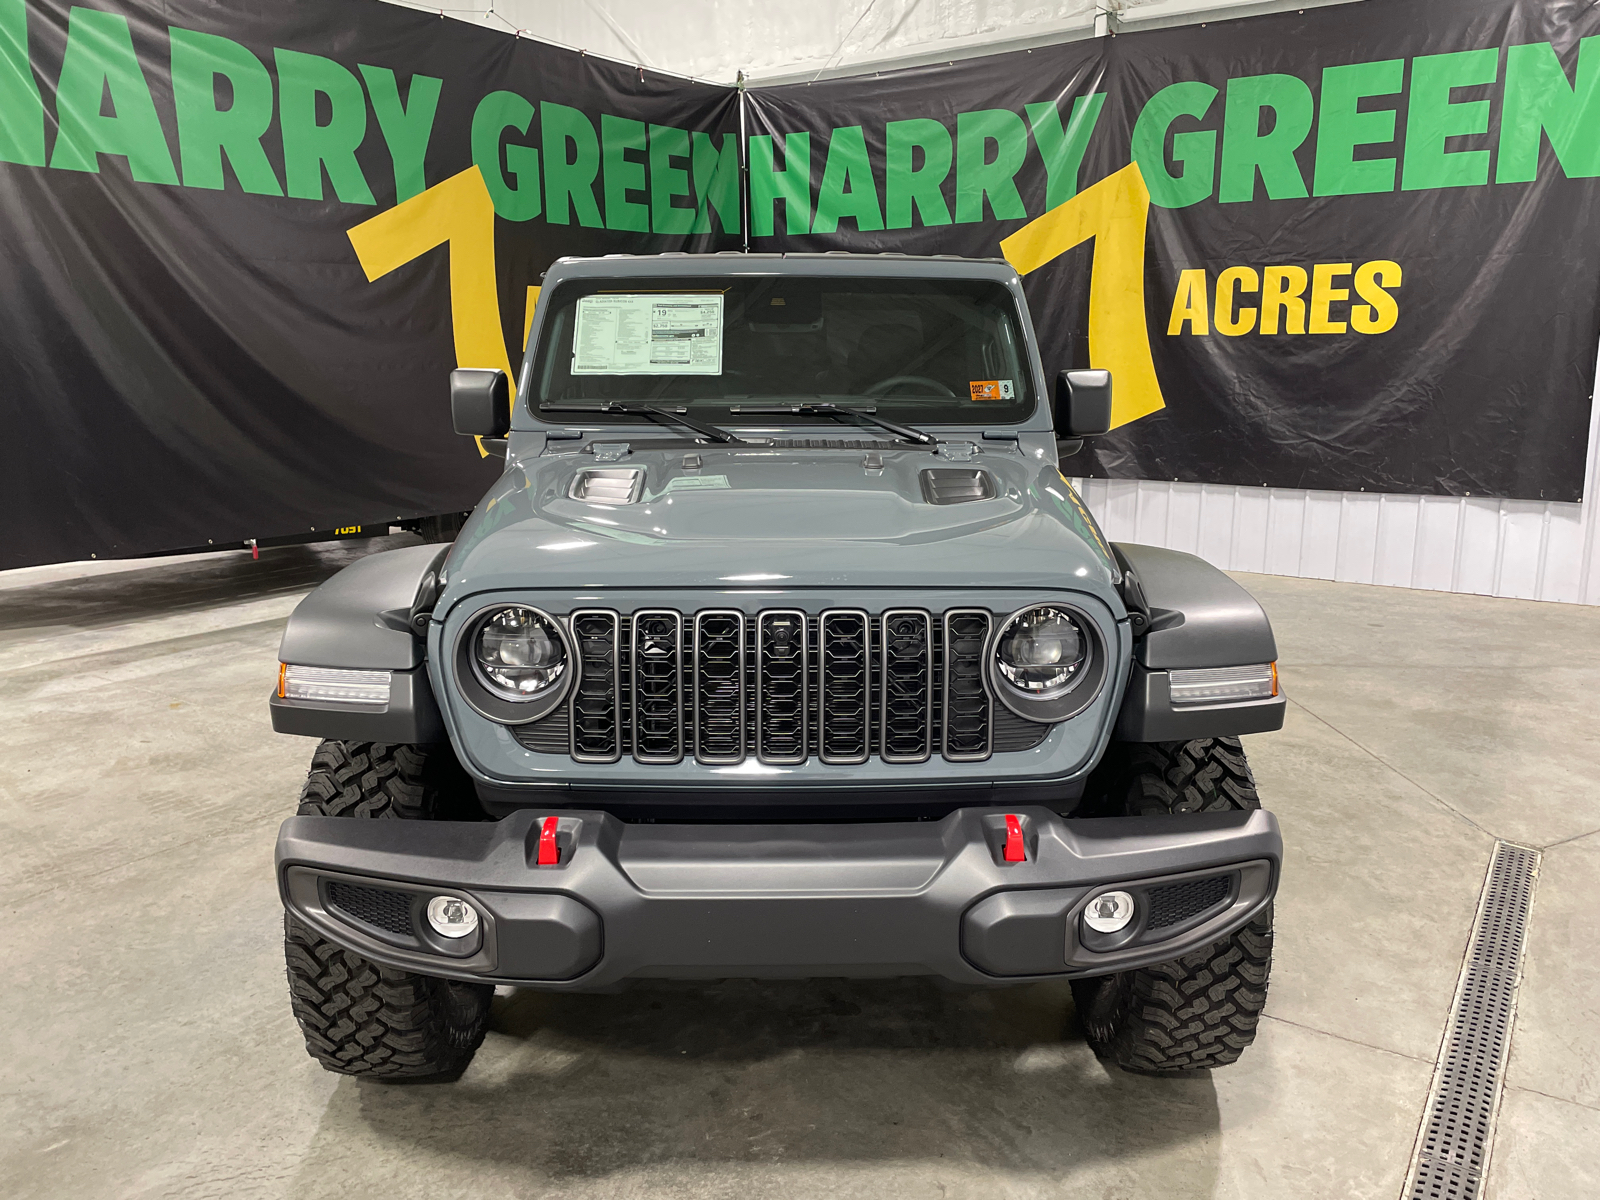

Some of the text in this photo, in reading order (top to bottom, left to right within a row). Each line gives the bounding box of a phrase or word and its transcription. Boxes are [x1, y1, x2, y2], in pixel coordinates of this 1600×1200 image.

[470, 91, 741, 235] GREEN
[749, 34, 1600, 237] HARRY GREEN
[347, 164, 517, 458] 7
[1000, 160, 1403, 430] 7 ACRES
[1004, 384, 1008, 393] 9
